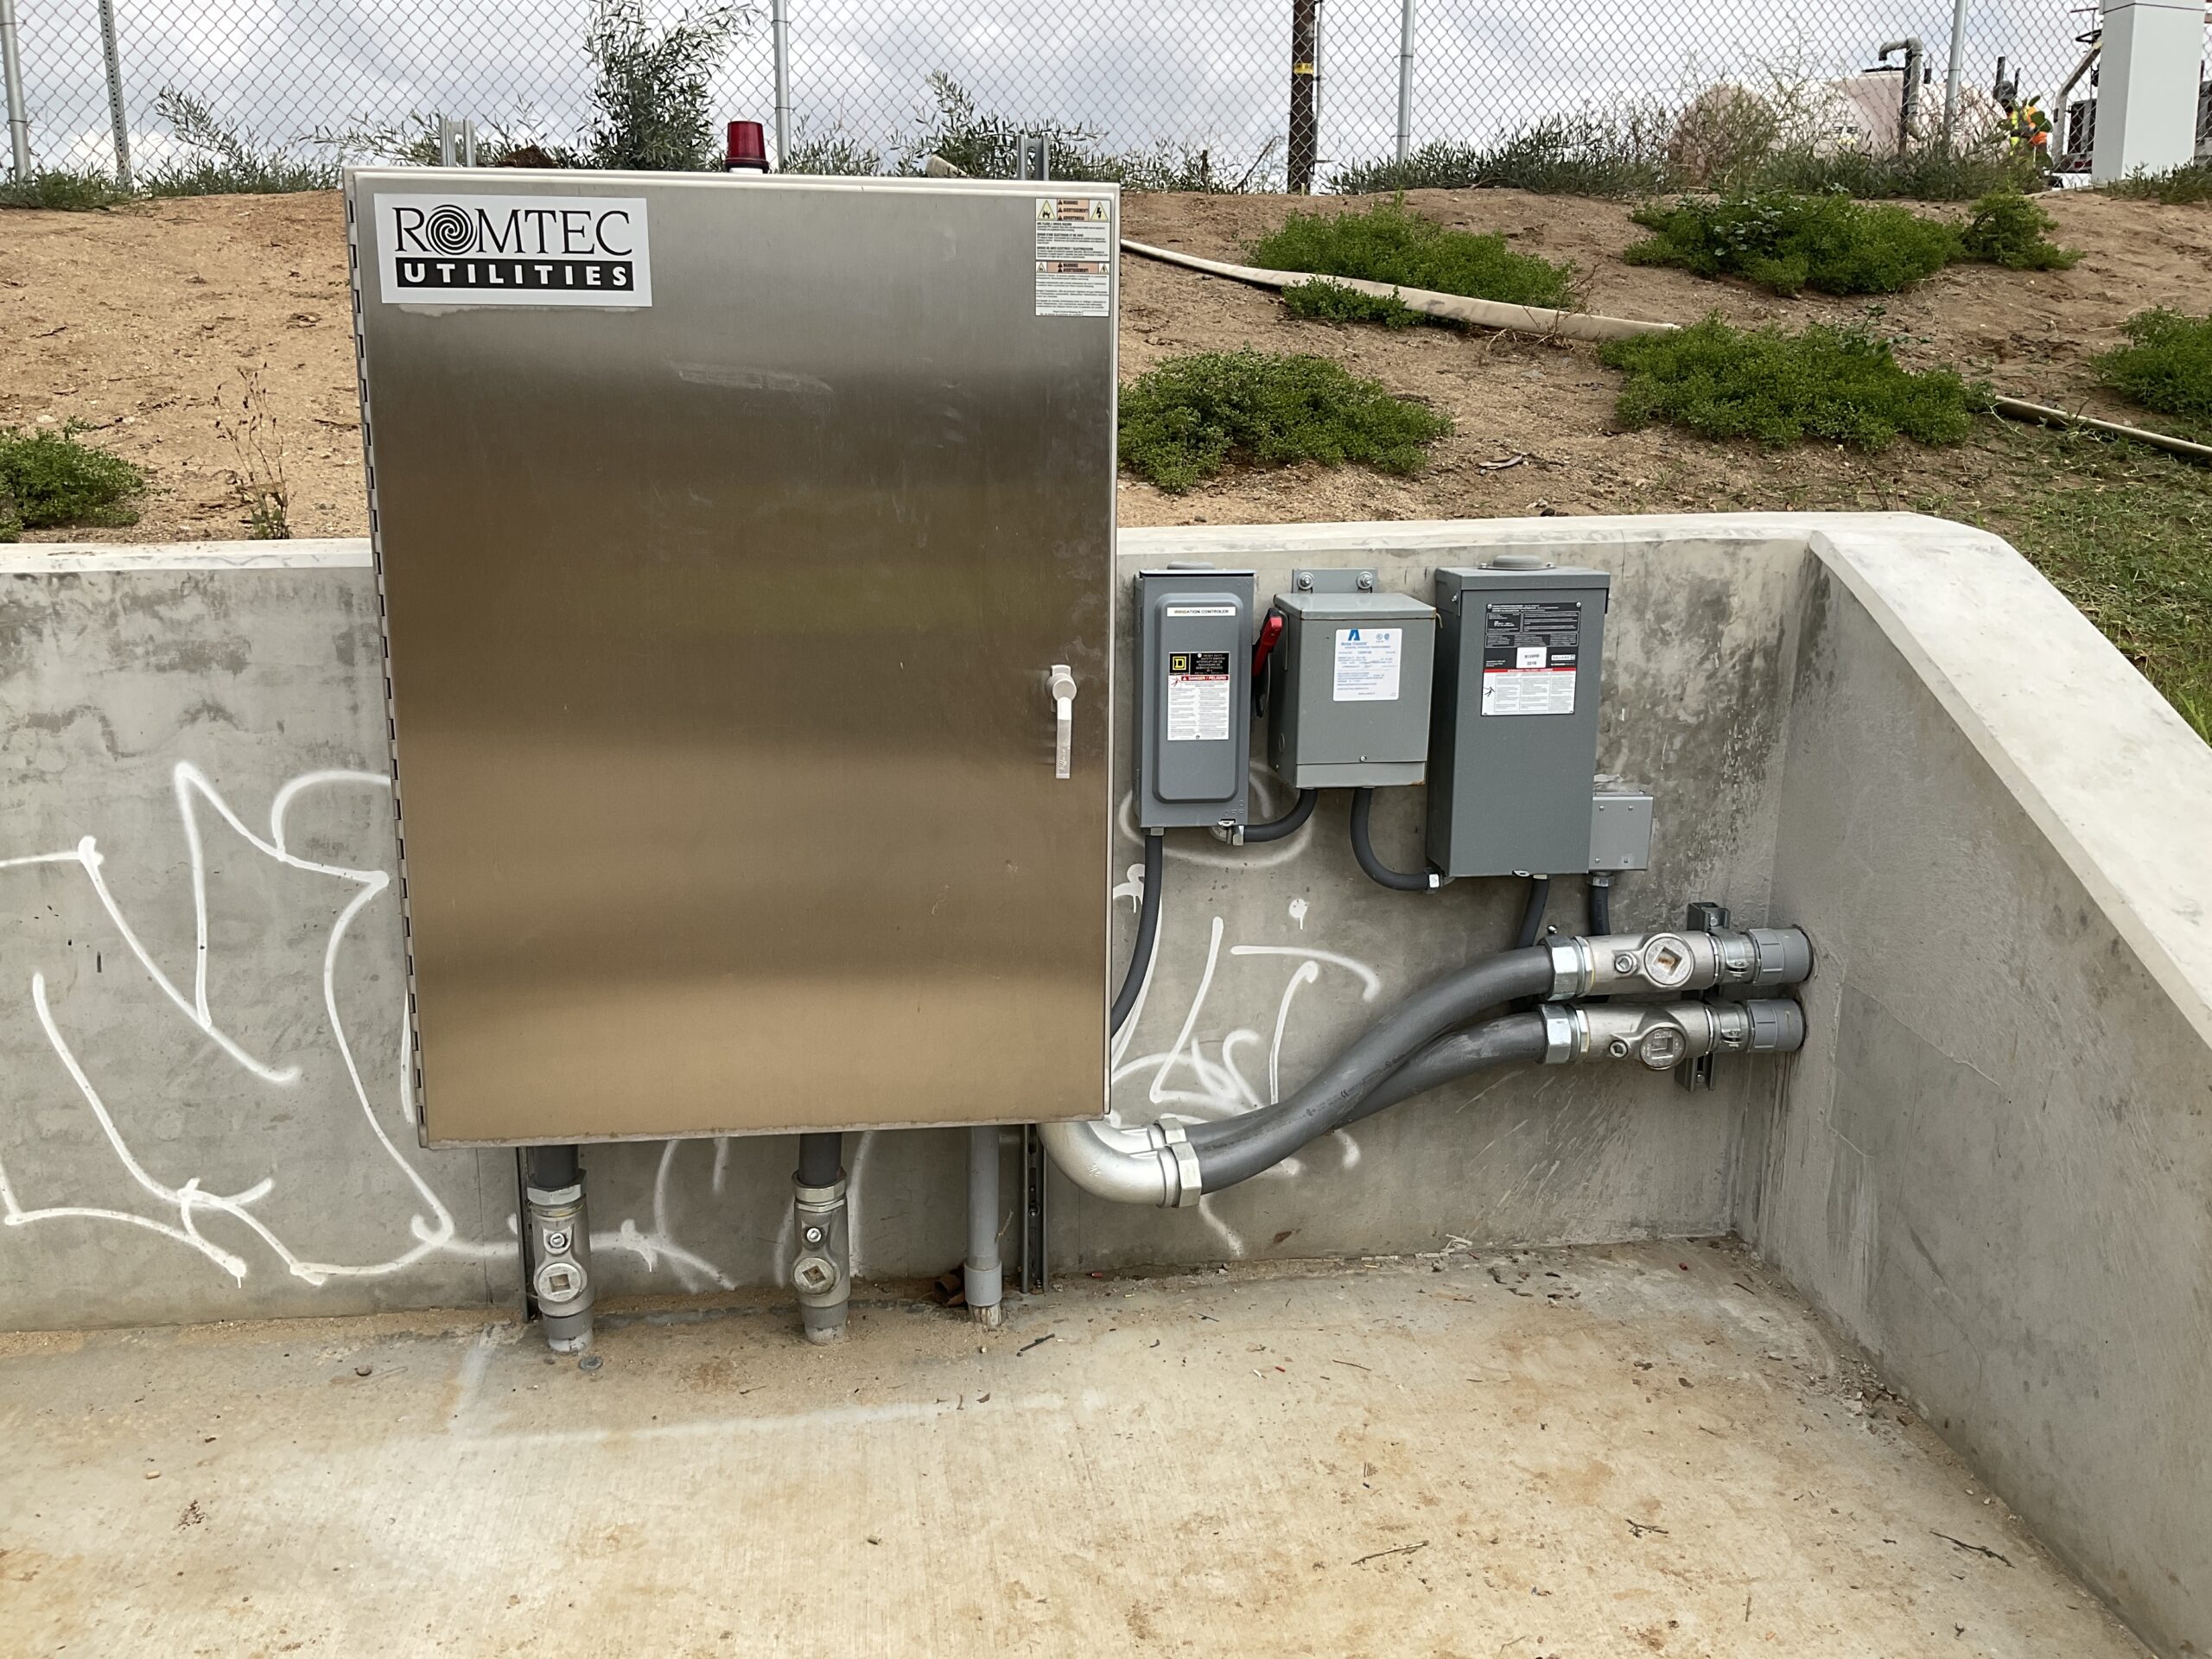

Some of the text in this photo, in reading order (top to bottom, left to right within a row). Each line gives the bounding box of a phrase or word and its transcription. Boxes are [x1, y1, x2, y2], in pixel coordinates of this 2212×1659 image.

[391, 204, 632, 257] ROMTEC
[404, 263, 628, 286] UTILITIES
[1174, 658, 1185, 669] D
